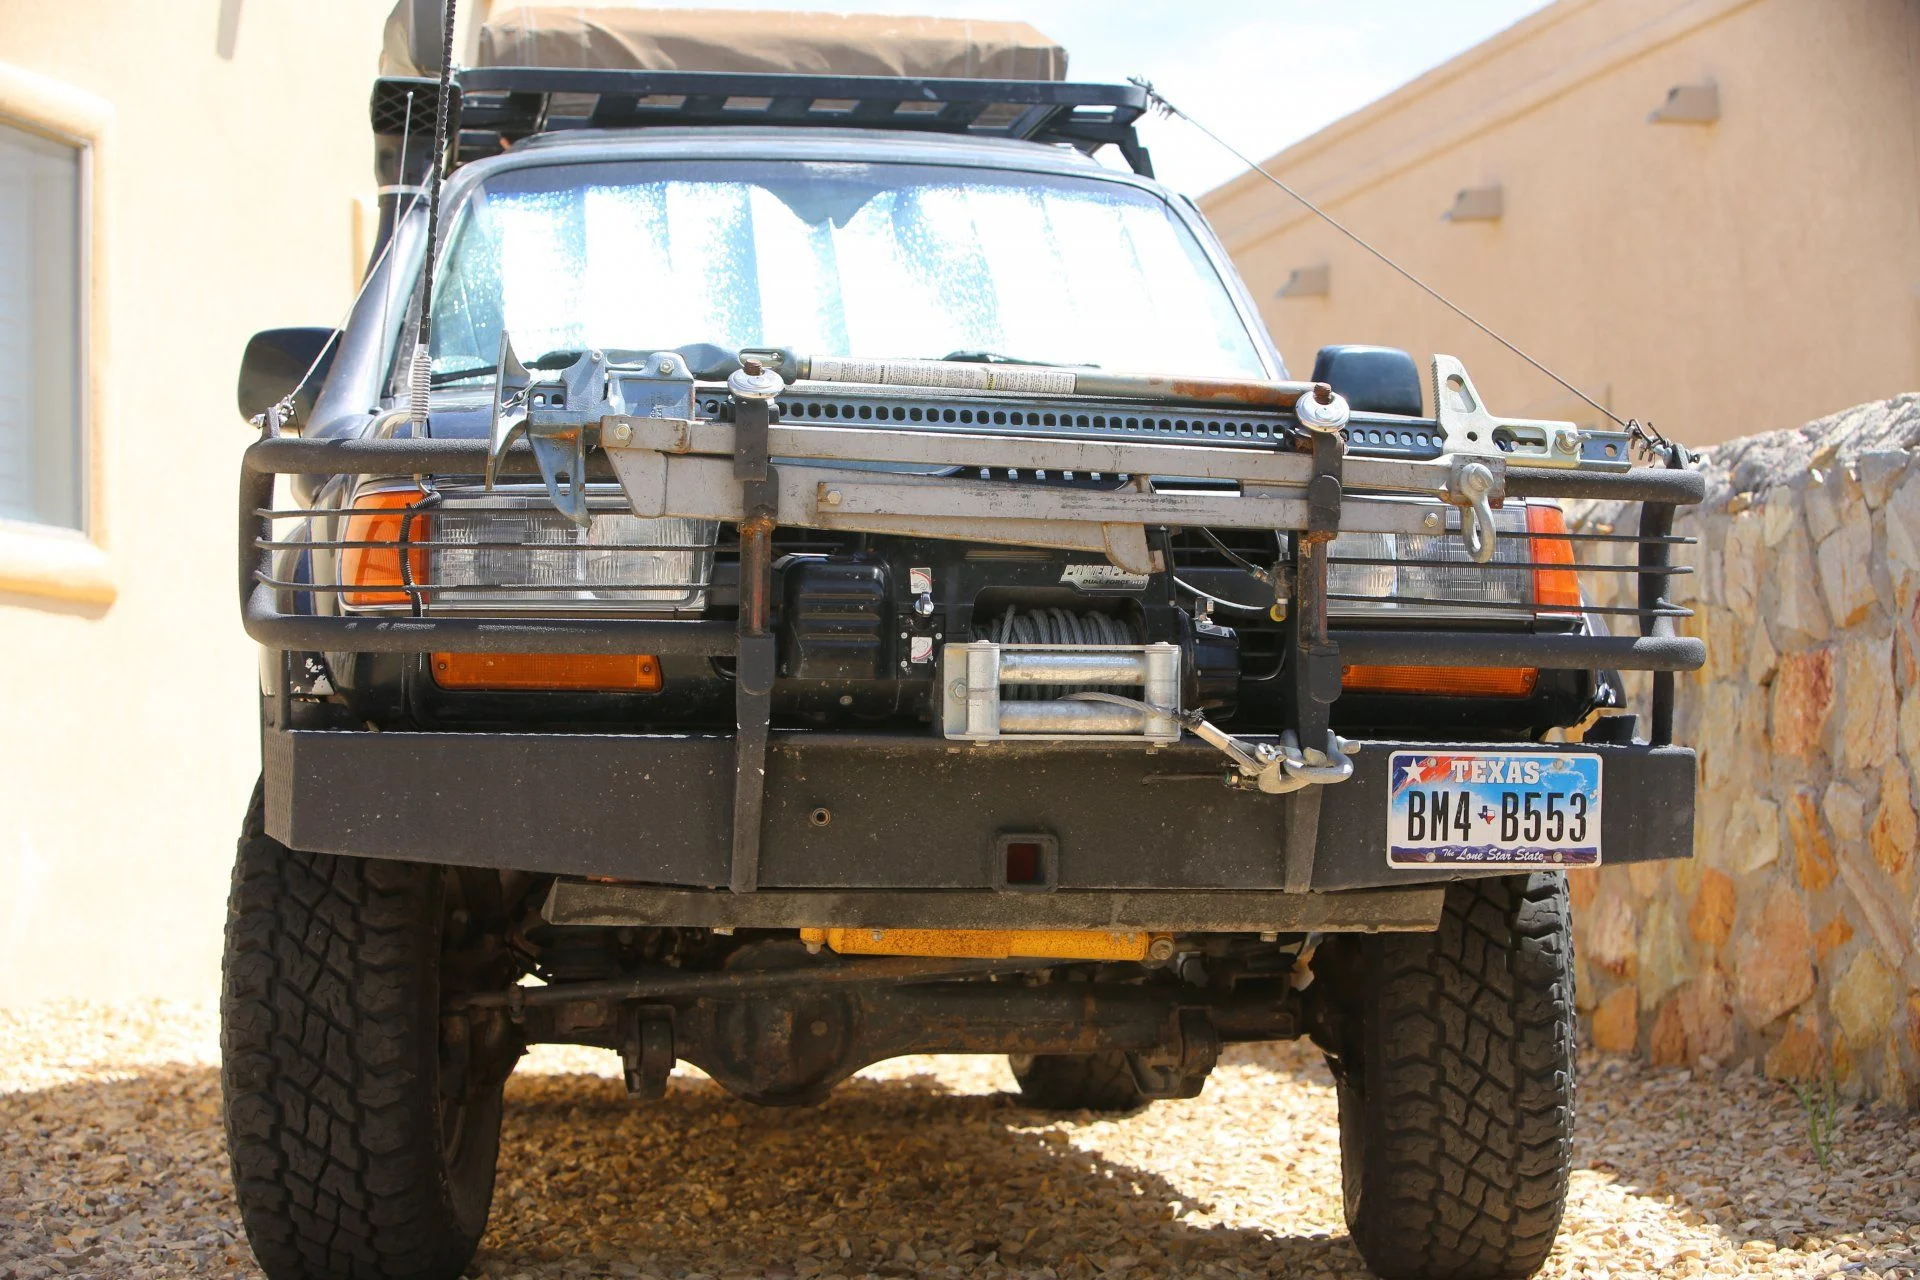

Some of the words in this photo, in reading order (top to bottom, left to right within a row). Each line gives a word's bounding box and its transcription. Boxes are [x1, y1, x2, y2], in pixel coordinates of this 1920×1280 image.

[1451, 761, 1540, 784] TEXAS
[1408, 791, 1471, 841] BM4
[1501, 792, 1586, 842] B553
[1442, 848, 1454, 857] The
[1456, 849, 1483, 861] Lone
[1487, 849, 1511, 861] Star
[1515, 850, 1544, 861] State
